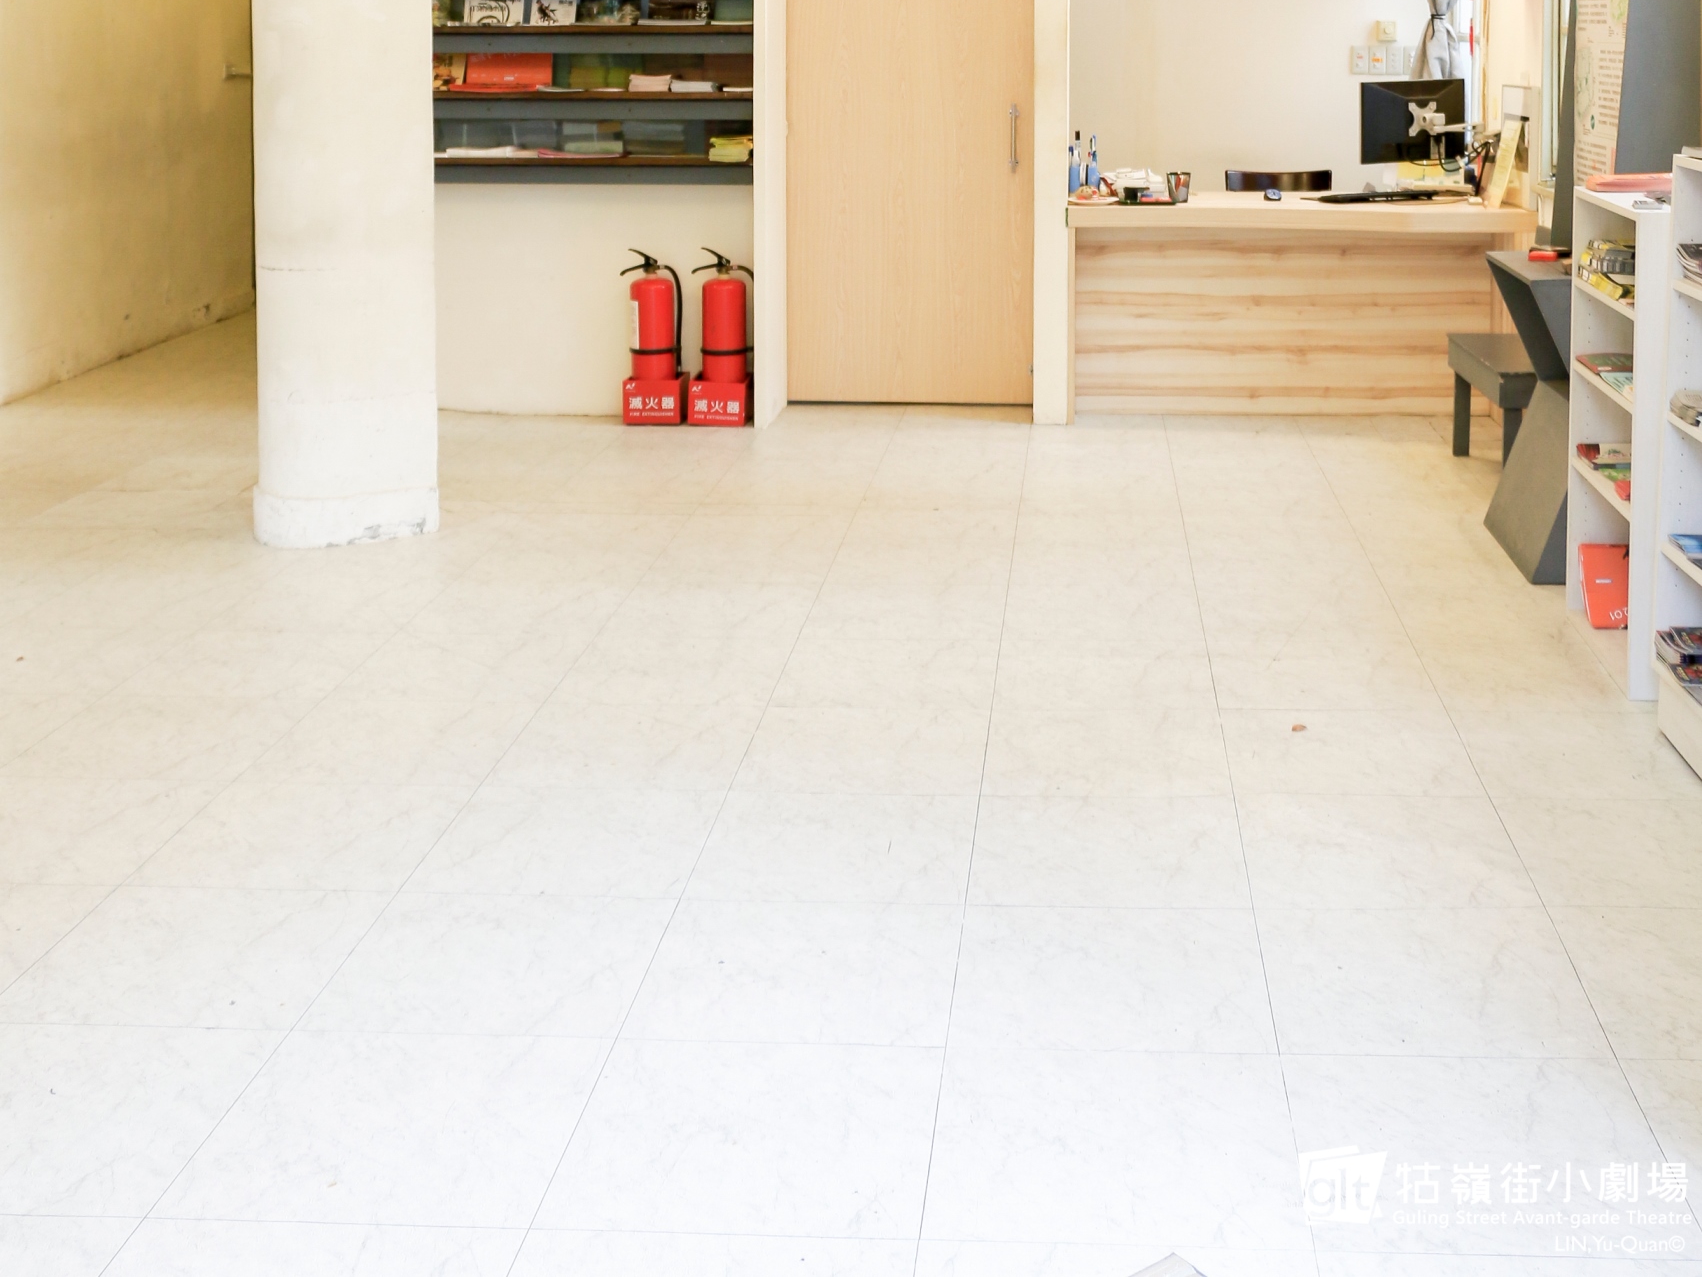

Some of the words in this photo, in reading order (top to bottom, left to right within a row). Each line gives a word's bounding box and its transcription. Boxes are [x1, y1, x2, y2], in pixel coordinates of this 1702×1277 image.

[628, 396, 675, 410] 滅火器
[693, 399, 740, 414] 滅火器
